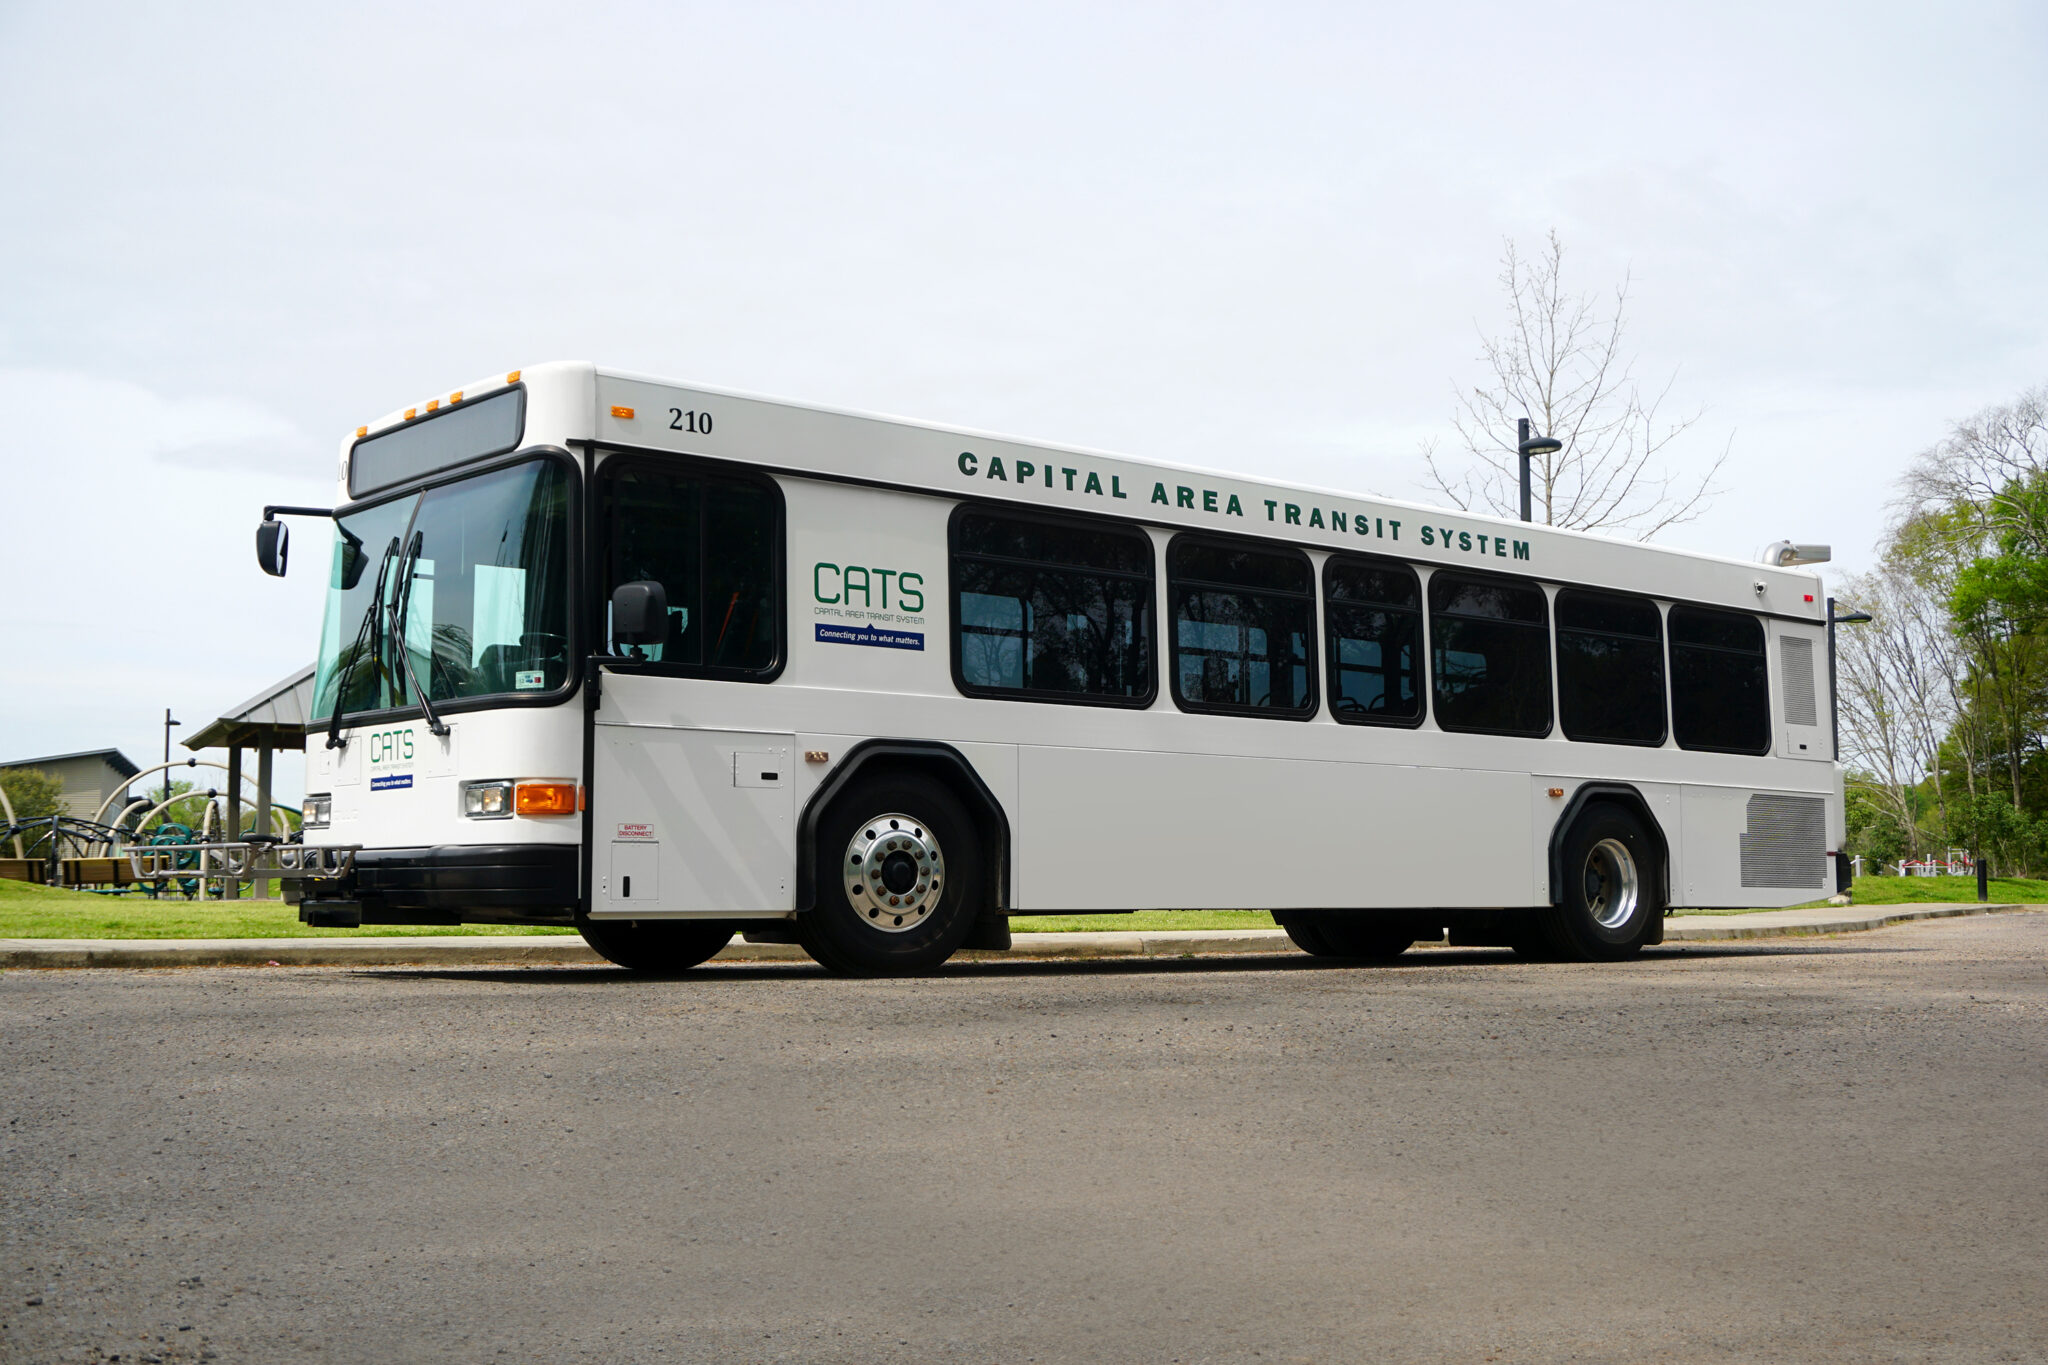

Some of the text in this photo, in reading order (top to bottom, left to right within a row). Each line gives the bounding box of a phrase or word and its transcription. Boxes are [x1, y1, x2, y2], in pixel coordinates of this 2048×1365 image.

[669, 407, 713, 435] 210
[957, 451, 1530, 561] CAPITAL AREA TRANSIT SYSTEM
[814, 562, 924, 613] CATS
[814, 606, 925, 625] CAPITAL AREA TRANSIT SYSTEM
[819, 628, 921, 646] Connecting you to what matters.
[371, 729, 414, 763] CATS
